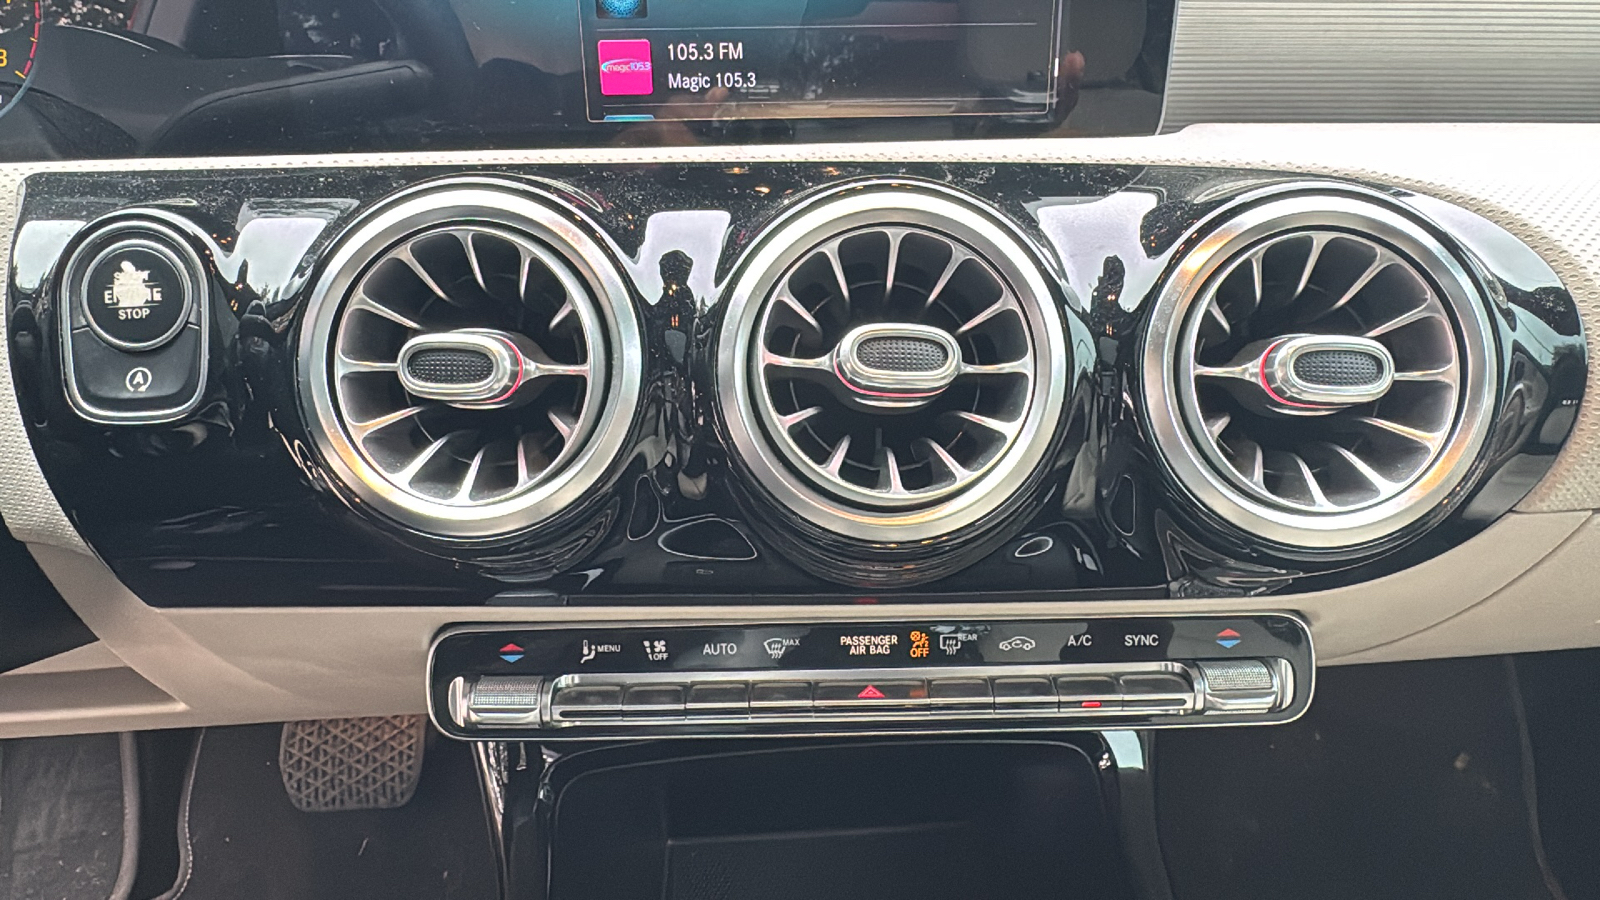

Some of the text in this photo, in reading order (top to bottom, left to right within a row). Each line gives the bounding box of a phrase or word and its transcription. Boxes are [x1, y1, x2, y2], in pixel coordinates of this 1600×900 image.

[667, 42, 744, 61] 105.3 FM
[668, 72, 757, 92] Magic 105.3
[118, 308, 150, 320] STOP
[783, 638, 800, 646] MAX
[840, 635, 898, 646] PASSENGER
[958, 633, 978, 641] REAR
[1067, 635, 1092, 646] A/C
[1124, 634, 1159, 647] SYNC
[597, 644, 621, 653] MENU
[702, 643, 737, 656] AUTO
[849, 644, 891, 655] AIR BAG
[910, 648, 930, 658] OFF
[653, 652, 669, 661] OFF
